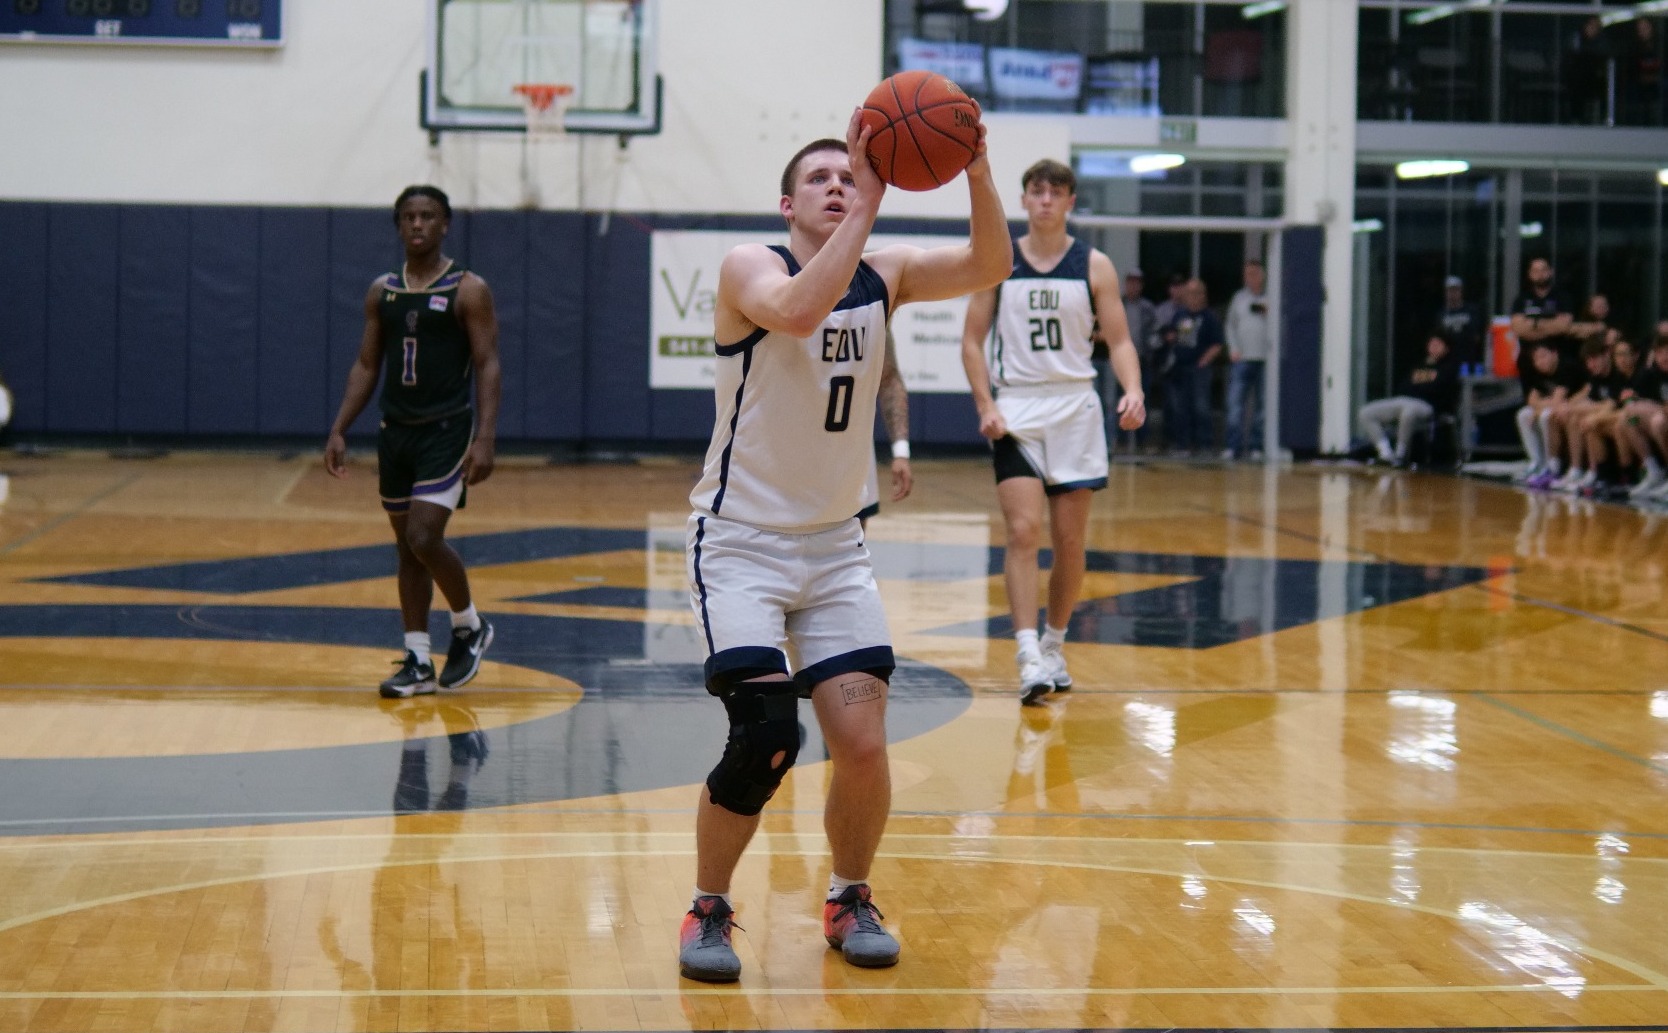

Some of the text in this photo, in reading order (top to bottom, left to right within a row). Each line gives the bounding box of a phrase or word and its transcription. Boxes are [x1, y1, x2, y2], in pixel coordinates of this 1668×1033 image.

[1028, 317, 1063, 351] 20
[402, 337, 417, 385] 1
[825, 376, 854, 432] 0
[846, 681, 879, 701] BELIEVE
